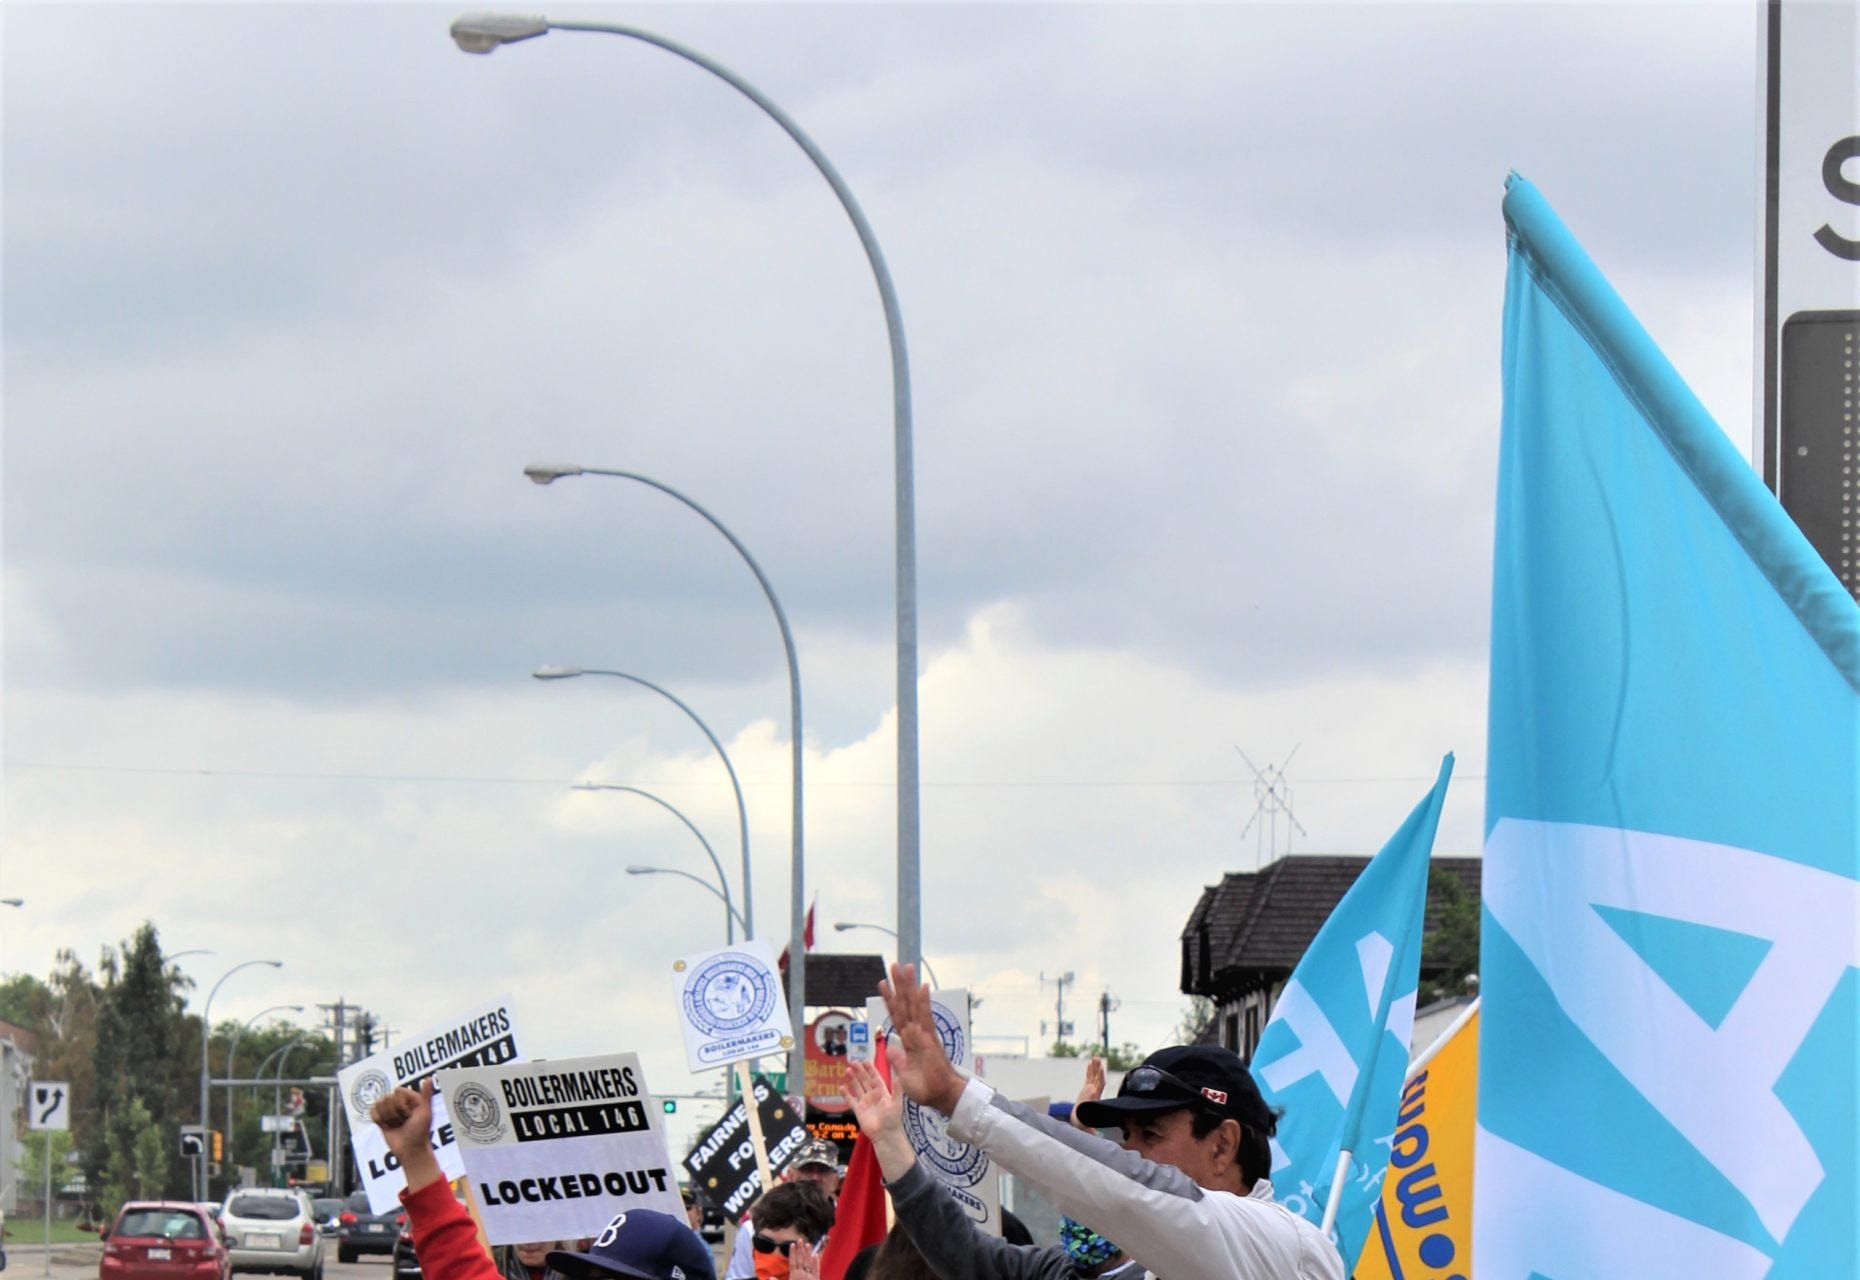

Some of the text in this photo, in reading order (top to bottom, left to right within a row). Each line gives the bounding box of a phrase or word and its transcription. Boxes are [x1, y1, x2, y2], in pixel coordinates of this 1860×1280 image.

[393, 1007, 510, 1080] BOILERMAKERS
[705, 1031, 775, 1053] BOILERMAKERS
[501, 1066, 638, 1108] BOILERMAKERS
[520, 1111, 589, 1137] LOCAL
[600, 1107, 640, 1130] 146
[689, 1084, 770, 1172] FAIRNES
[724, 1126, 806, 1214] WORERS
[728, 1136, 767, 1171] FO
[480, 1168, 668, 1205] LOCKEDOUT
[593, 1213, 626, 1247] B
